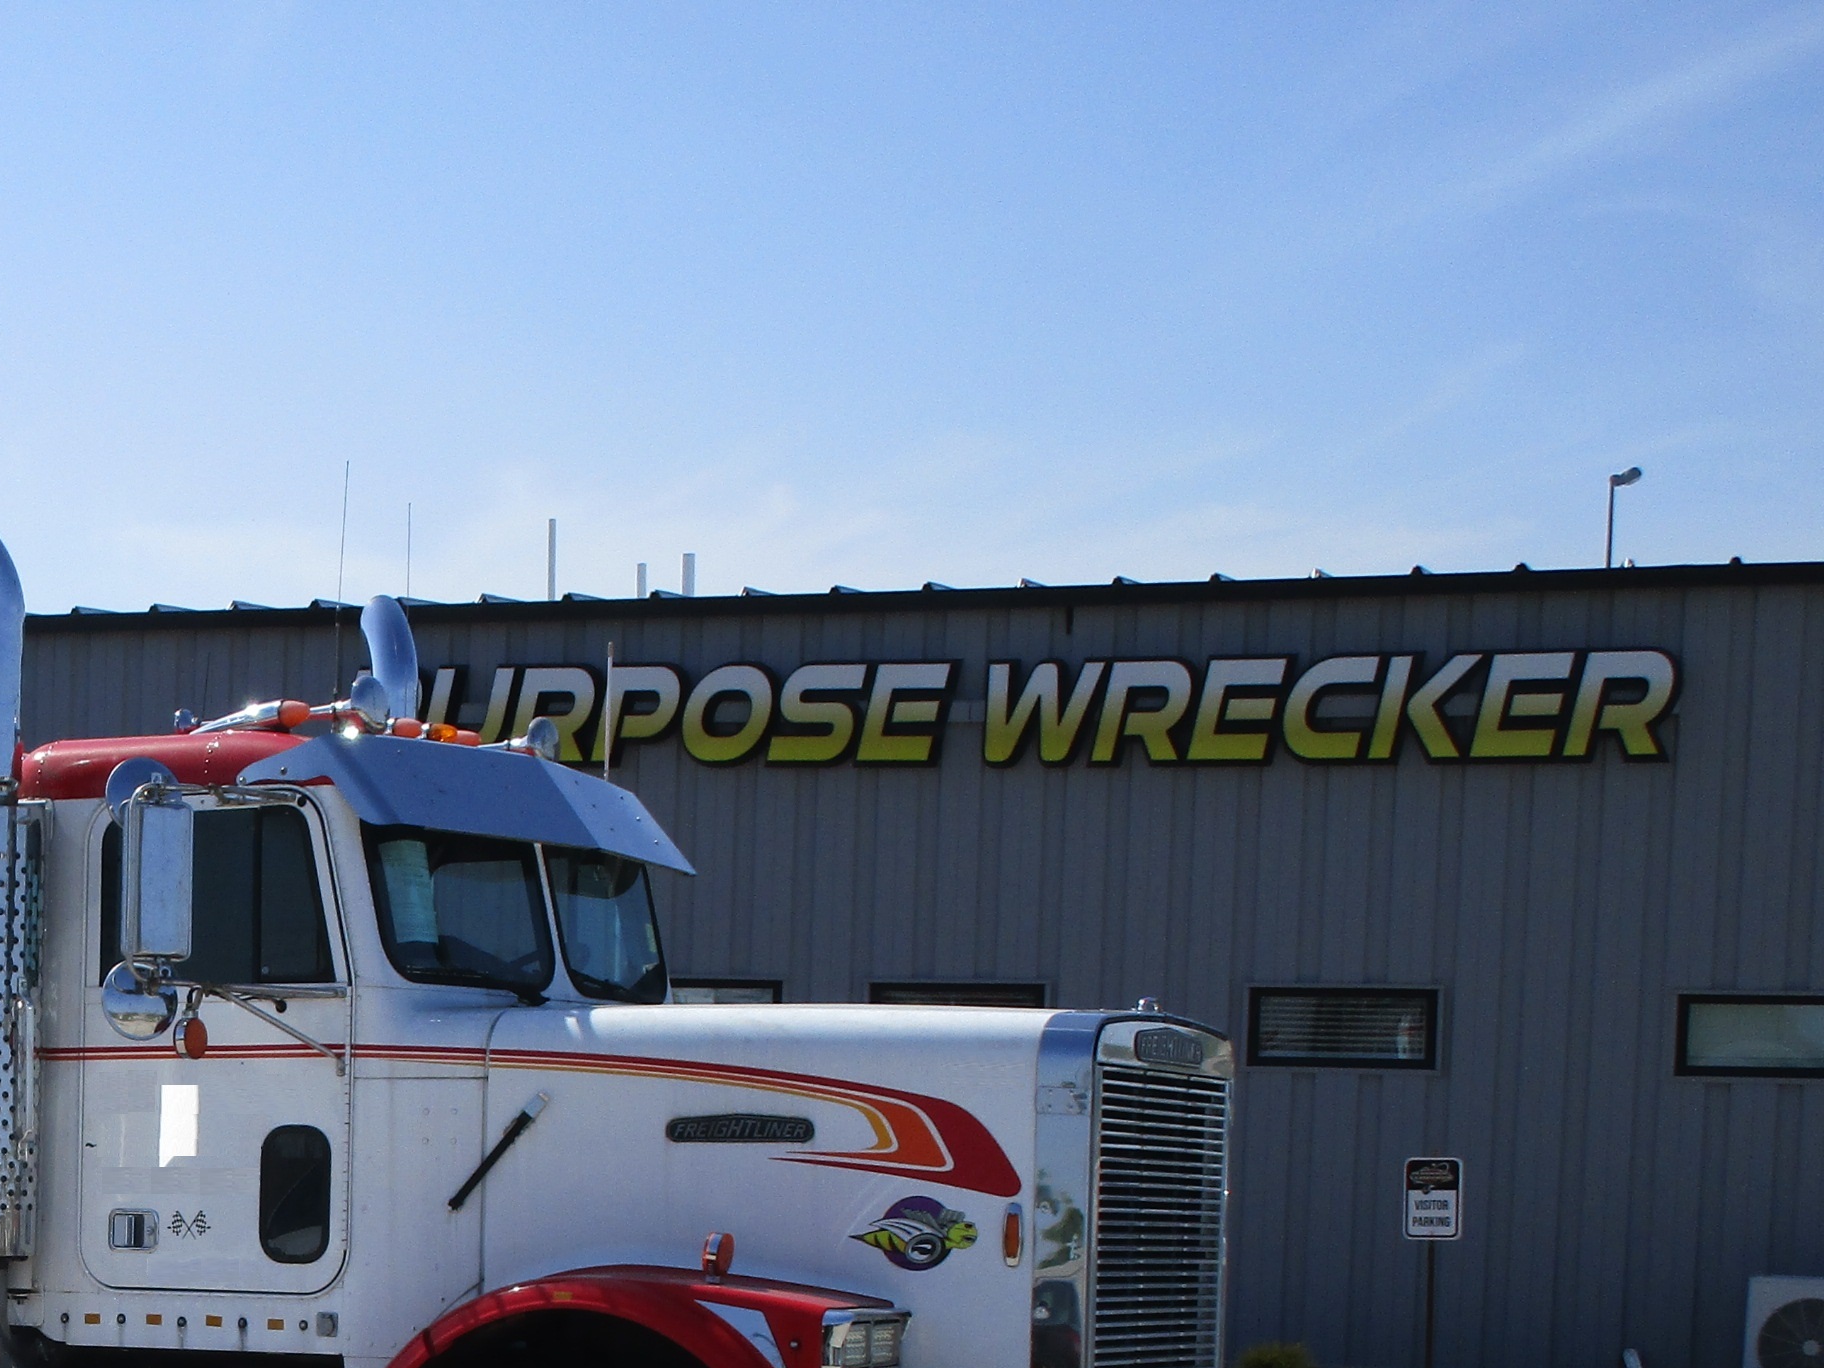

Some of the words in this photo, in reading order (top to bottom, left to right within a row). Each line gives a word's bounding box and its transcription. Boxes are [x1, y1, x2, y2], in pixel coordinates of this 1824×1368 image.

[417, 662, 955, 764] URPOSE
[984, 649, 1680, 765] WRECKER
[675, 1119, 807, 1138] FREIGHTLINER
[1414, 1200, 1449, 1210] VISITOR
[1412, 1217, 1451, 1227] PARKING
